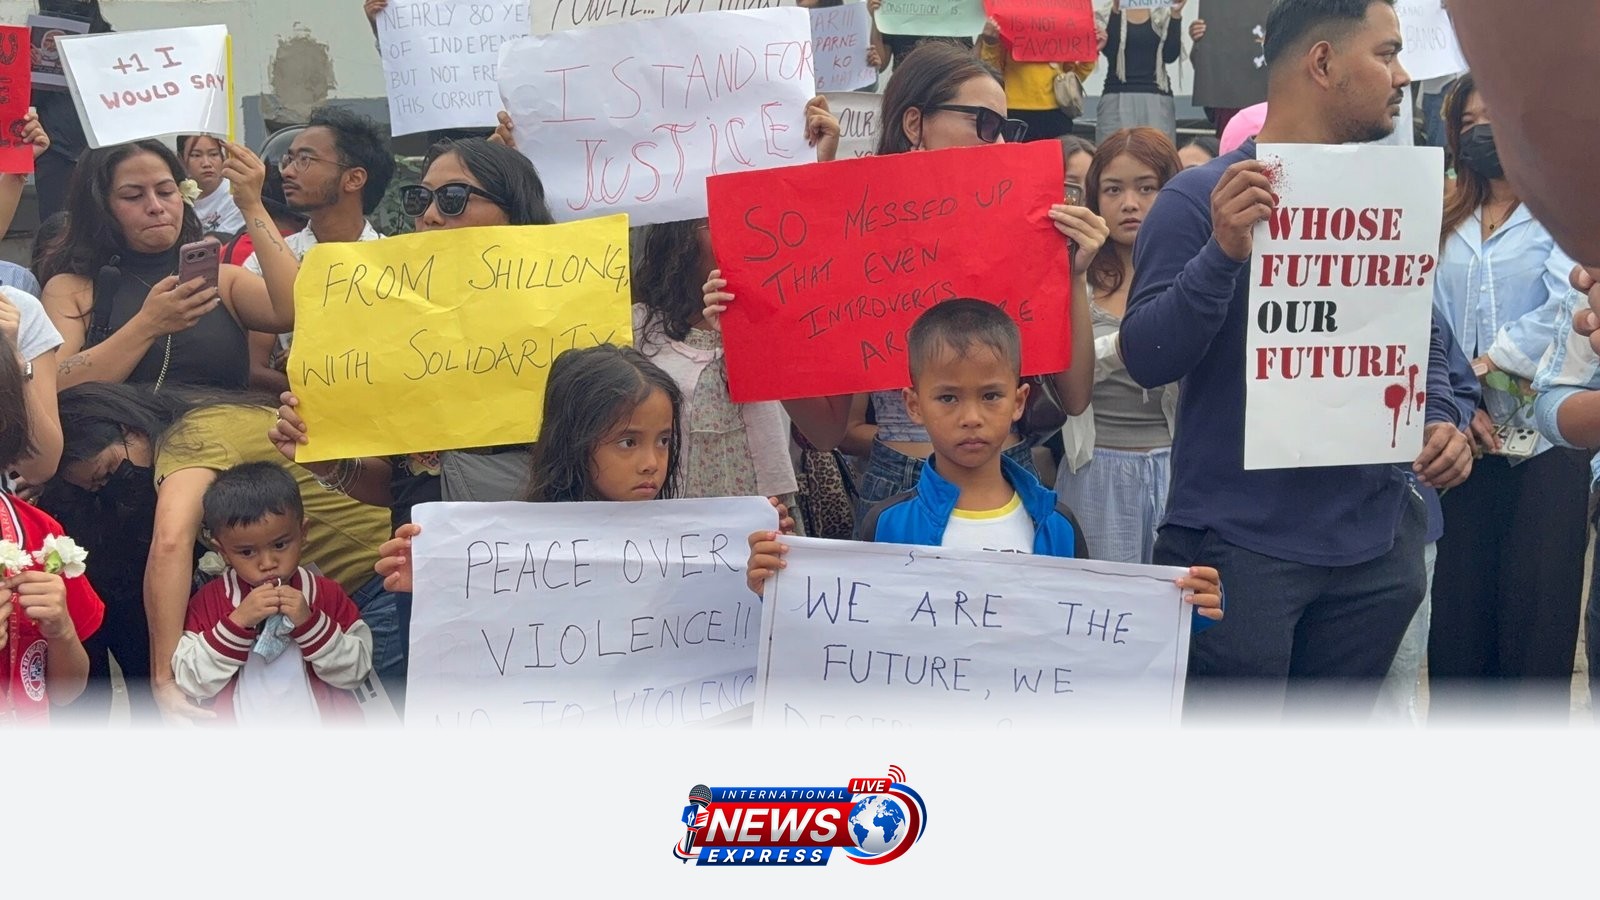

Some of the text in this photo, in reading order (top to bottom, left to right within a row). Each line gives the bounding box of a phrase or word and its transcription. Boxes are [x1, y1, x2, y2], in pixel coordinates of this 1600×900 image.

[384, 2, 457, 31] NEARLY
[469, 4, 494, 26] 80
[112, 46, 182, 76] +1 I
[389, 40, 413, 60] OF
[99, 73, 225, 110] WOULD SAY
[391, 69, 418, 89] BUT
[430, 66, 461, 84] NOT
[541, 40, 817, 123] I STAND FOR
[394, 90, 494, 116] THIS CORRUPT
[743, 178, 1014, 262] SO MESSED UP
[1268, 206, 1403, 242] WHOSE
[323, 243, 630, 308] FROM SHILLONG,
[761, 238, 940, 305] THAT EVEN
[1258, 253, 1435, 288] FUTURE?
[799, 280, 957, 340] INTROVERTS
[1256, 300, 1338, 334] OUR
[302, 348, 374, 388] WITH
[466, 533, 739, 599] PEACE OVER
[805, 575, 1133, 645] WE ARE THE
[481, 601, 752, 677] VIOLENCE!!
[822, 643, 1074, 700] FUTURE, WE
